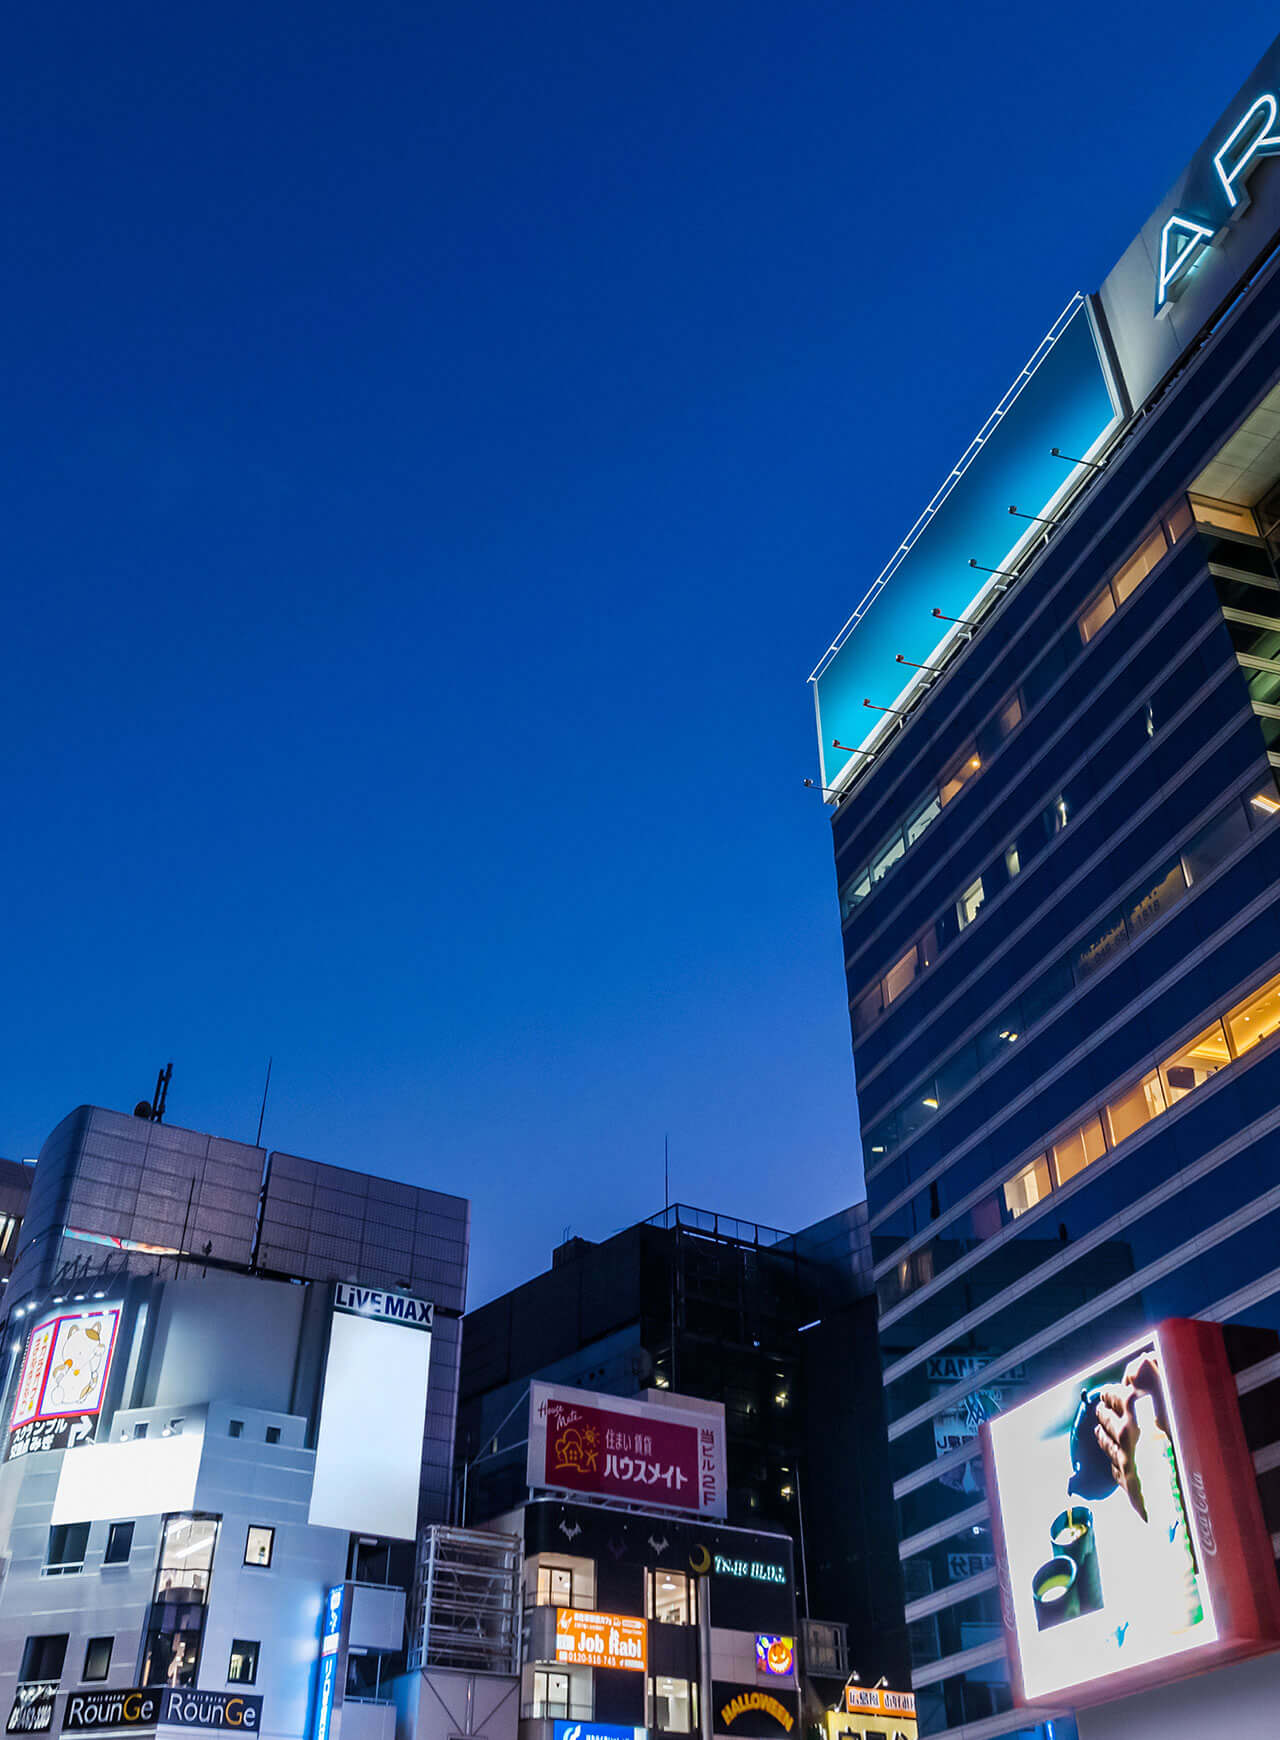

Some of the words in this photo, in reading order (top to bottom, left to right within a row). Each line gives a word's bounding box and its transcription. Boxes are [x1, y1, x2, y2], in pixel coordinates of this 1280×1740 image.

[603, 1453, 689, 1490] ハウスメイト
[700, 1428, 716, 1506] 当ビル2F
[577, 1631, 605, 1654] Job
[721, 1691, 795, 1733] HALLOWEEN
